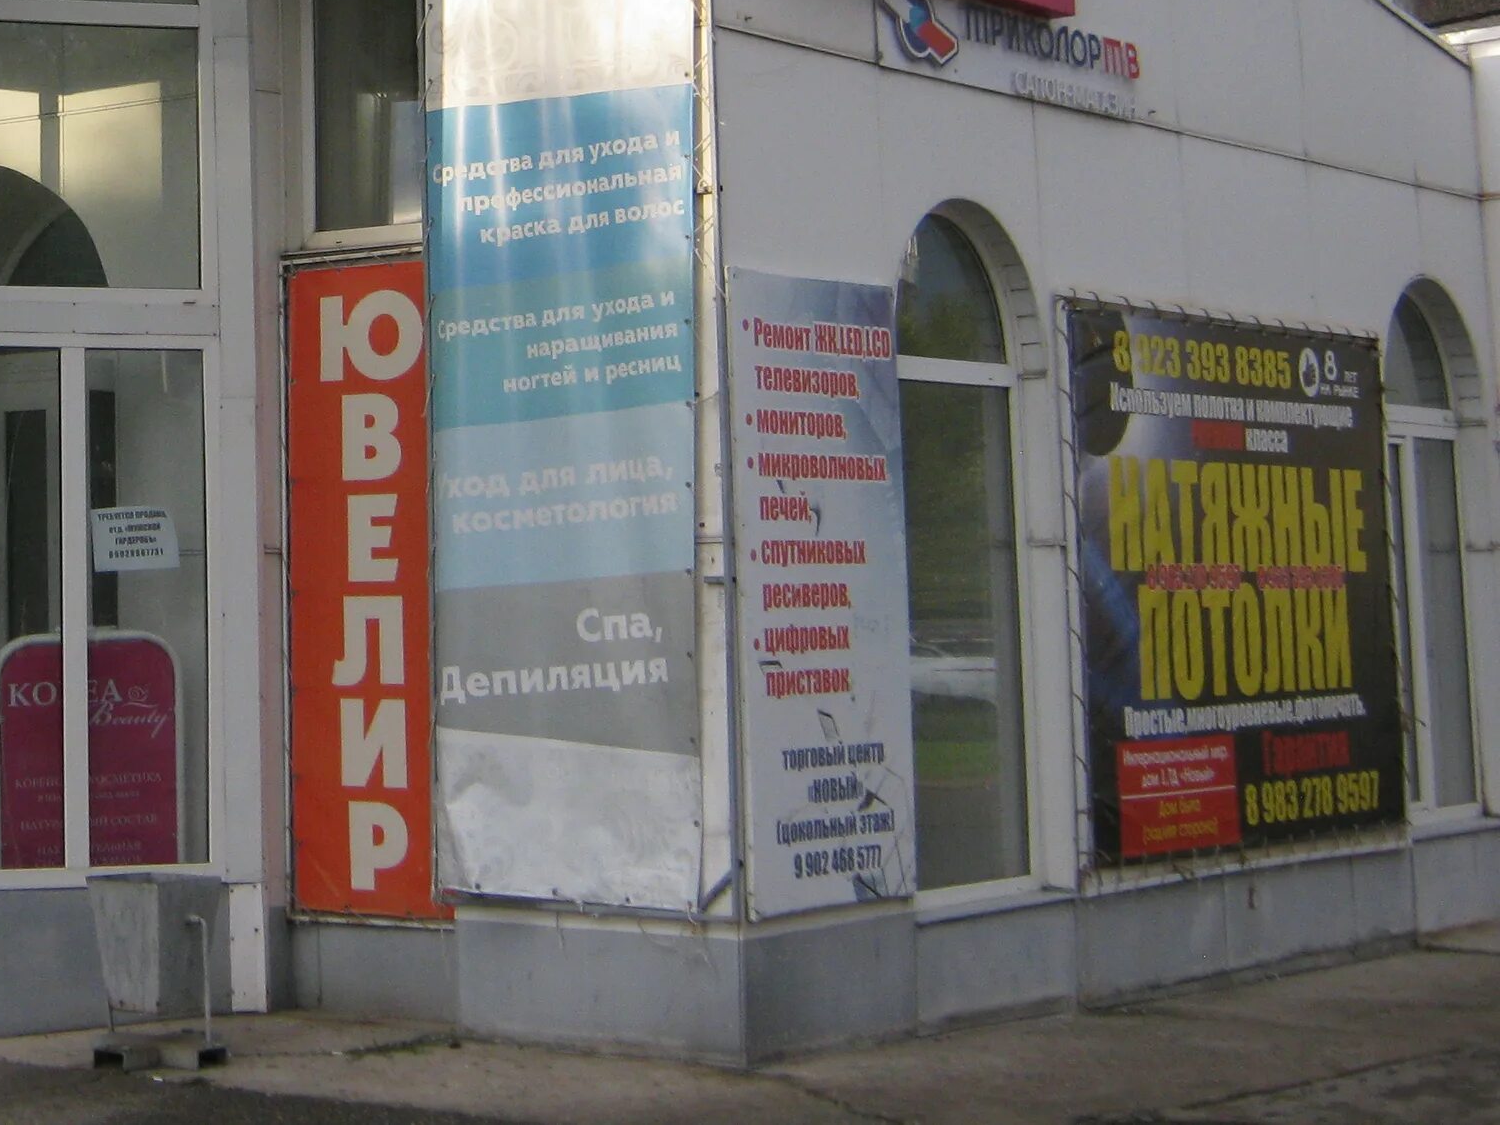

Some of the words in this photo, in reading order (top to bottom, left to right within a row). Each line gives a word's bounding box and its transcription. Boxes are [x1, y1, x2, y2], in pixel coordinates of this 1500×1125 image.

[539, 145, 585, 170] для
[589, 133, 658, 165] ухода
[666, 130, 680, 146] и
[459, 162, 684, 216] профессиональная
[480, 219, 561, 247] краска
[567, 210, 609, 235] для
[614, 199, 685, 224] волос
[542, 303, 585, 327] для
[591, 292, 655, 320] ухода
[660, 290, 675, 305] и
[527, 322, 678, 360] наращивания
[754, 317, 811, 350] Ремонт
[503, 364, 579, 393] ногтей
[585, 366, 599, 382] и
[606, 354, 682, 385] ресниц
[1112, 330, 1130, 372] 8
[1134, 334, 1181, 378] 923
[1186, 340, 1230, 384] 393
[1235, 345, 1291, 389] 8385
[520, 466, 576, 495] для
[585, 455, 674, 485] лица,
[758, 452, 887, 481] микроволновых
[453, 492, 678, 534] косметология
[1108, 456, 1367, 572] НАТЯЖНЫЕ
[762, 539, 866, 568] спутниковых
[319, 289, 424, 892] ЮВЕЛИР
[576, 607, 663, 643] Спа,
[764, 624, 850, 656] цифровых
[1137, 582, 1353, 701] ПОТОЛКИ
[7, 679, 123, 708] KOEA
[440, 657, 669, 705] Депиляция
[1245, 783, 1260, 825] 8
